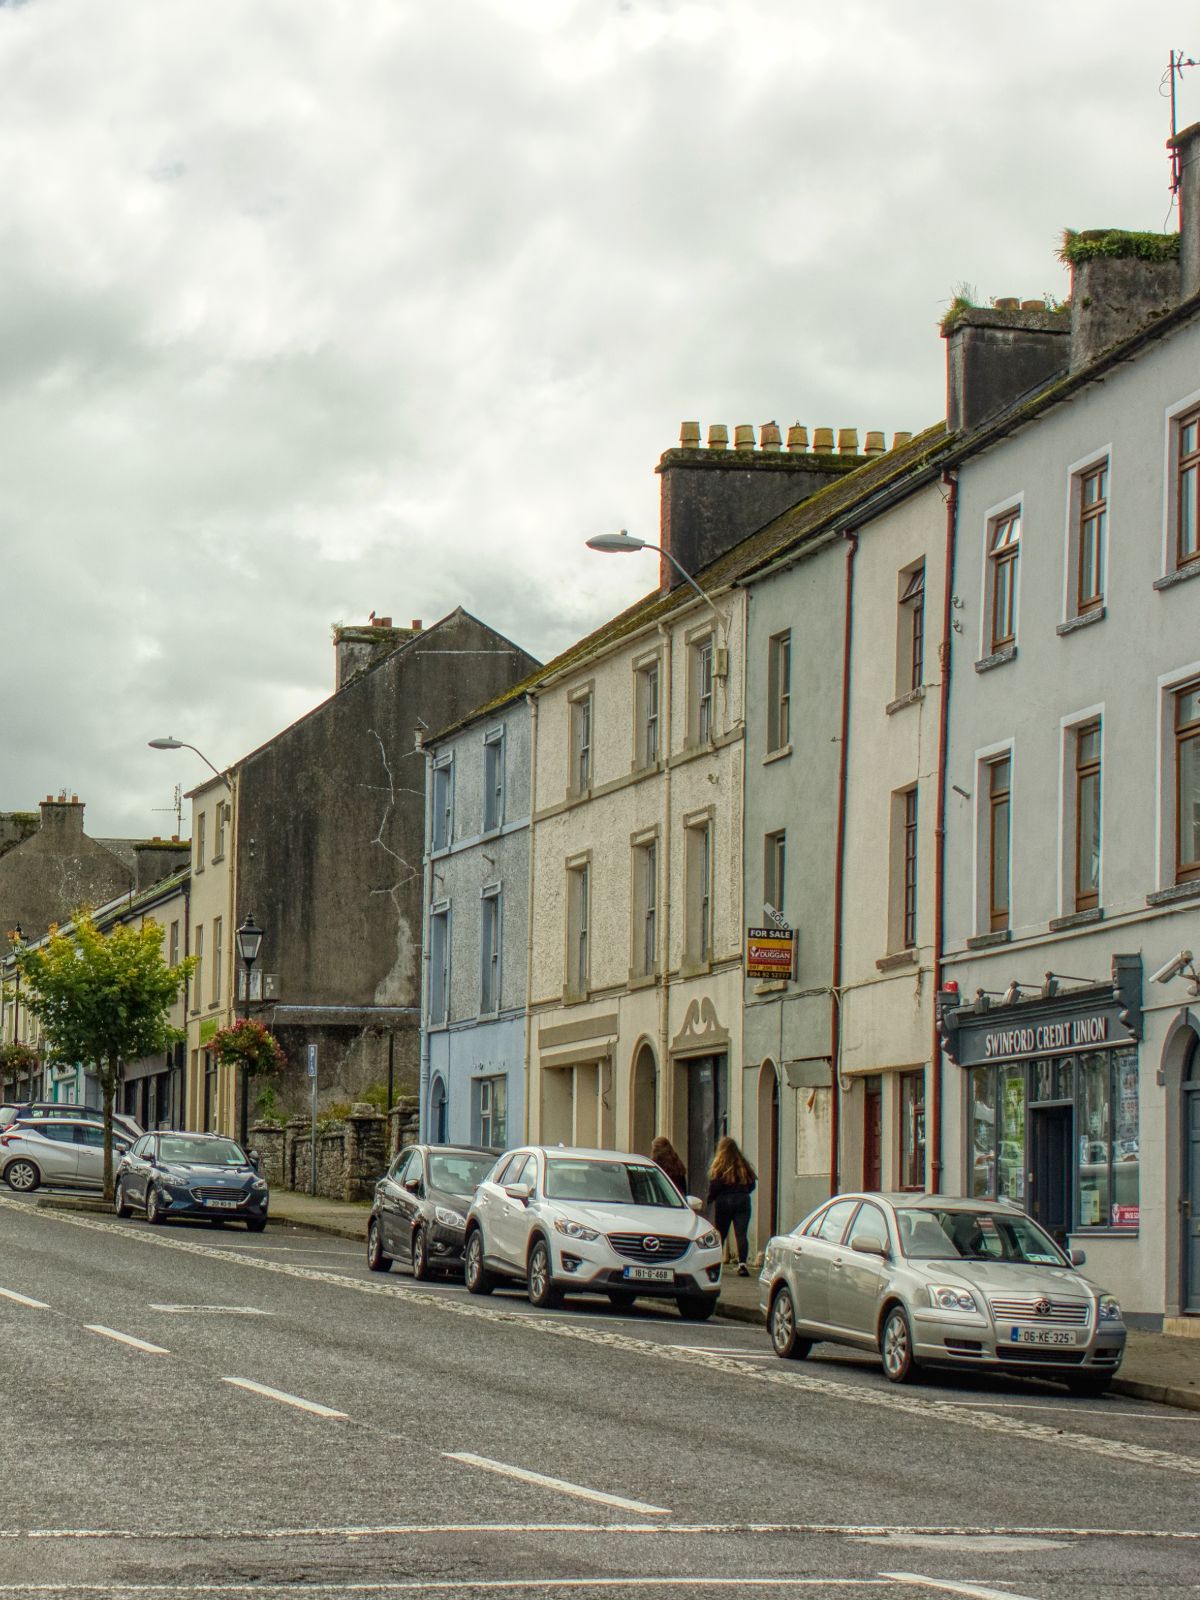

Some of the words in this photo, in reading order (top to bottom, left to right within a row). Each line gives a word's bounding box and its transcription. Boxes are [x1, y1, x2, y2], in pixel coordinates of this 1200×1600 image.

[770, 910, 789, 930] SOLD
[750, 929, 767, 937] FOR
[769, 930, 790, 938] SALE
[760, 951, 791, 959] DUGGAN
[985, 1028, 1034, 1056] SWINFORD
[1036, 1021, 1072, 1049] CREDIT
[1073, 1017, 1107, 1044] UNION
[1024, 1332, 1069, 1343] 06-KE-325
